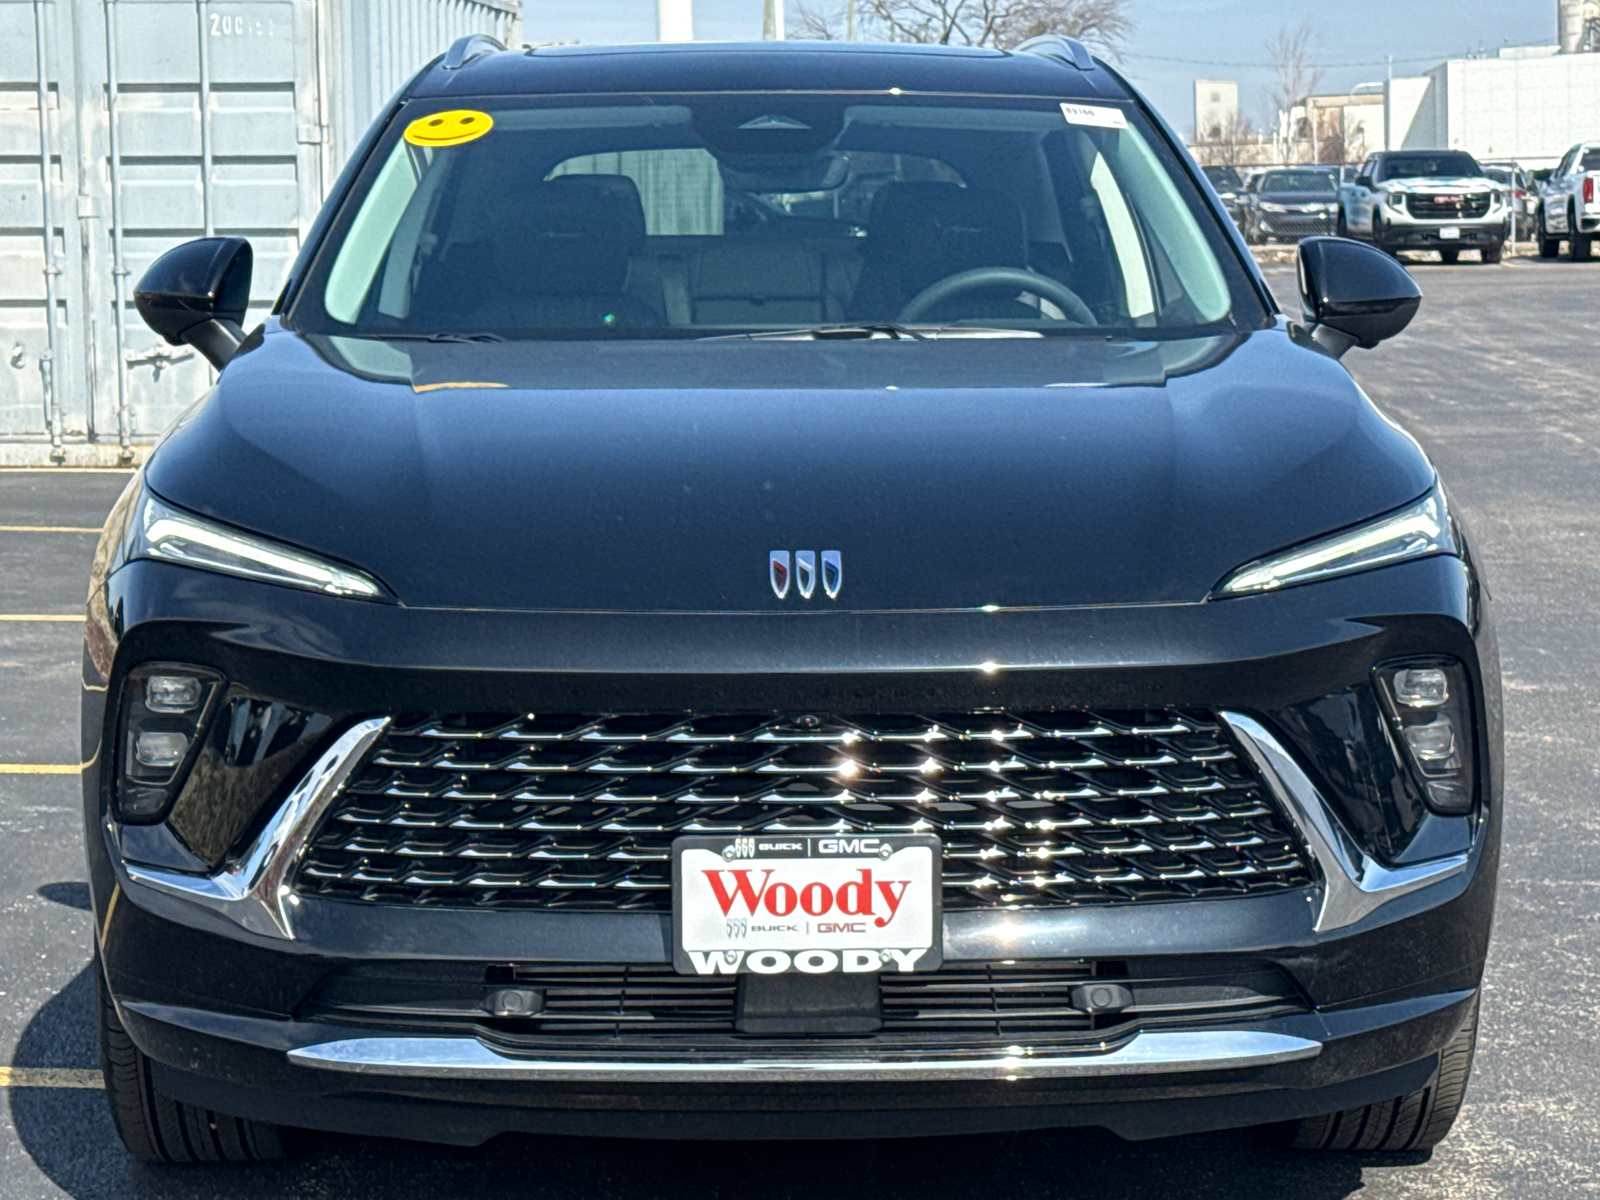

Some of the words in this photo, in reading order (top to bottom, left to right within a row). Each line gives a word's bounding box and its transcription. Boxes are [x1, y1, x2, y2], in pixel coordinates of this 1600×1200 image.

[758, 841, 803, 851] BUICK
[818, 838, 880, 854] GMC
[700, 868, 912, 928] Woody
[751, 924, 798, 932] BUICK
[817, 922, 867, 934] GMC
[688, 948, 928, 975] WOODY
